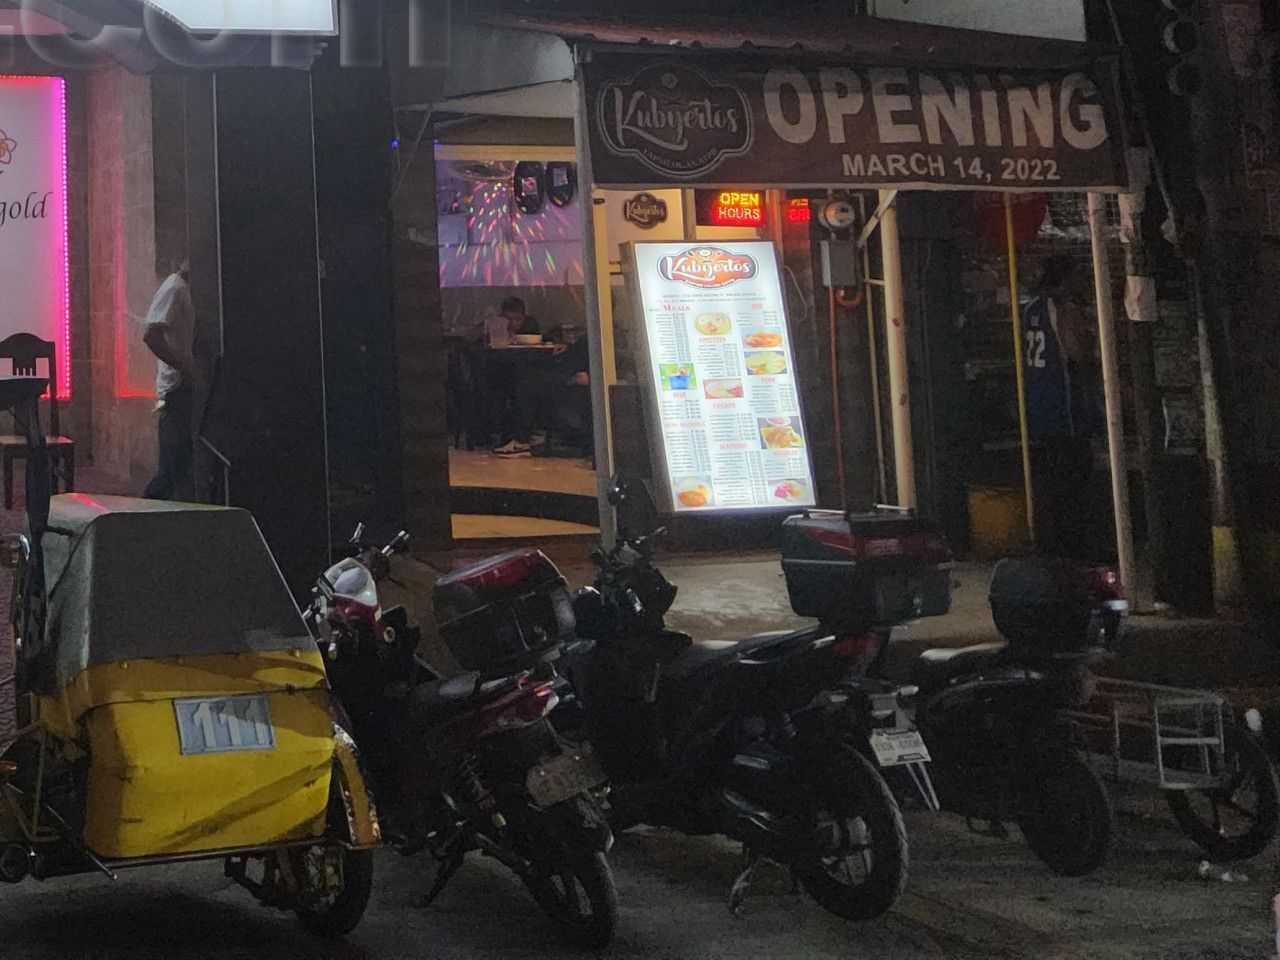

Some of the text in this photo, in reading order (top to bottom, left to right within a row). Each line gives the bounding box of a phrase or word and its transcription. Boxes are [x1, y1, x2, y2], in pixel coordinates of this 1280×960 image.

[613, 86, 739, 151] Kubyertos
[762, 65, 1109, 150] OPENING
[842, 152, 1062, 183] MARCH 14, 2022
[717, 206, 762, 221] HOURS
[719, 192, 760, 206] OPEN
[665, 255, 752, 282] Kubyertos
[192, 697, 270, 749] 111
